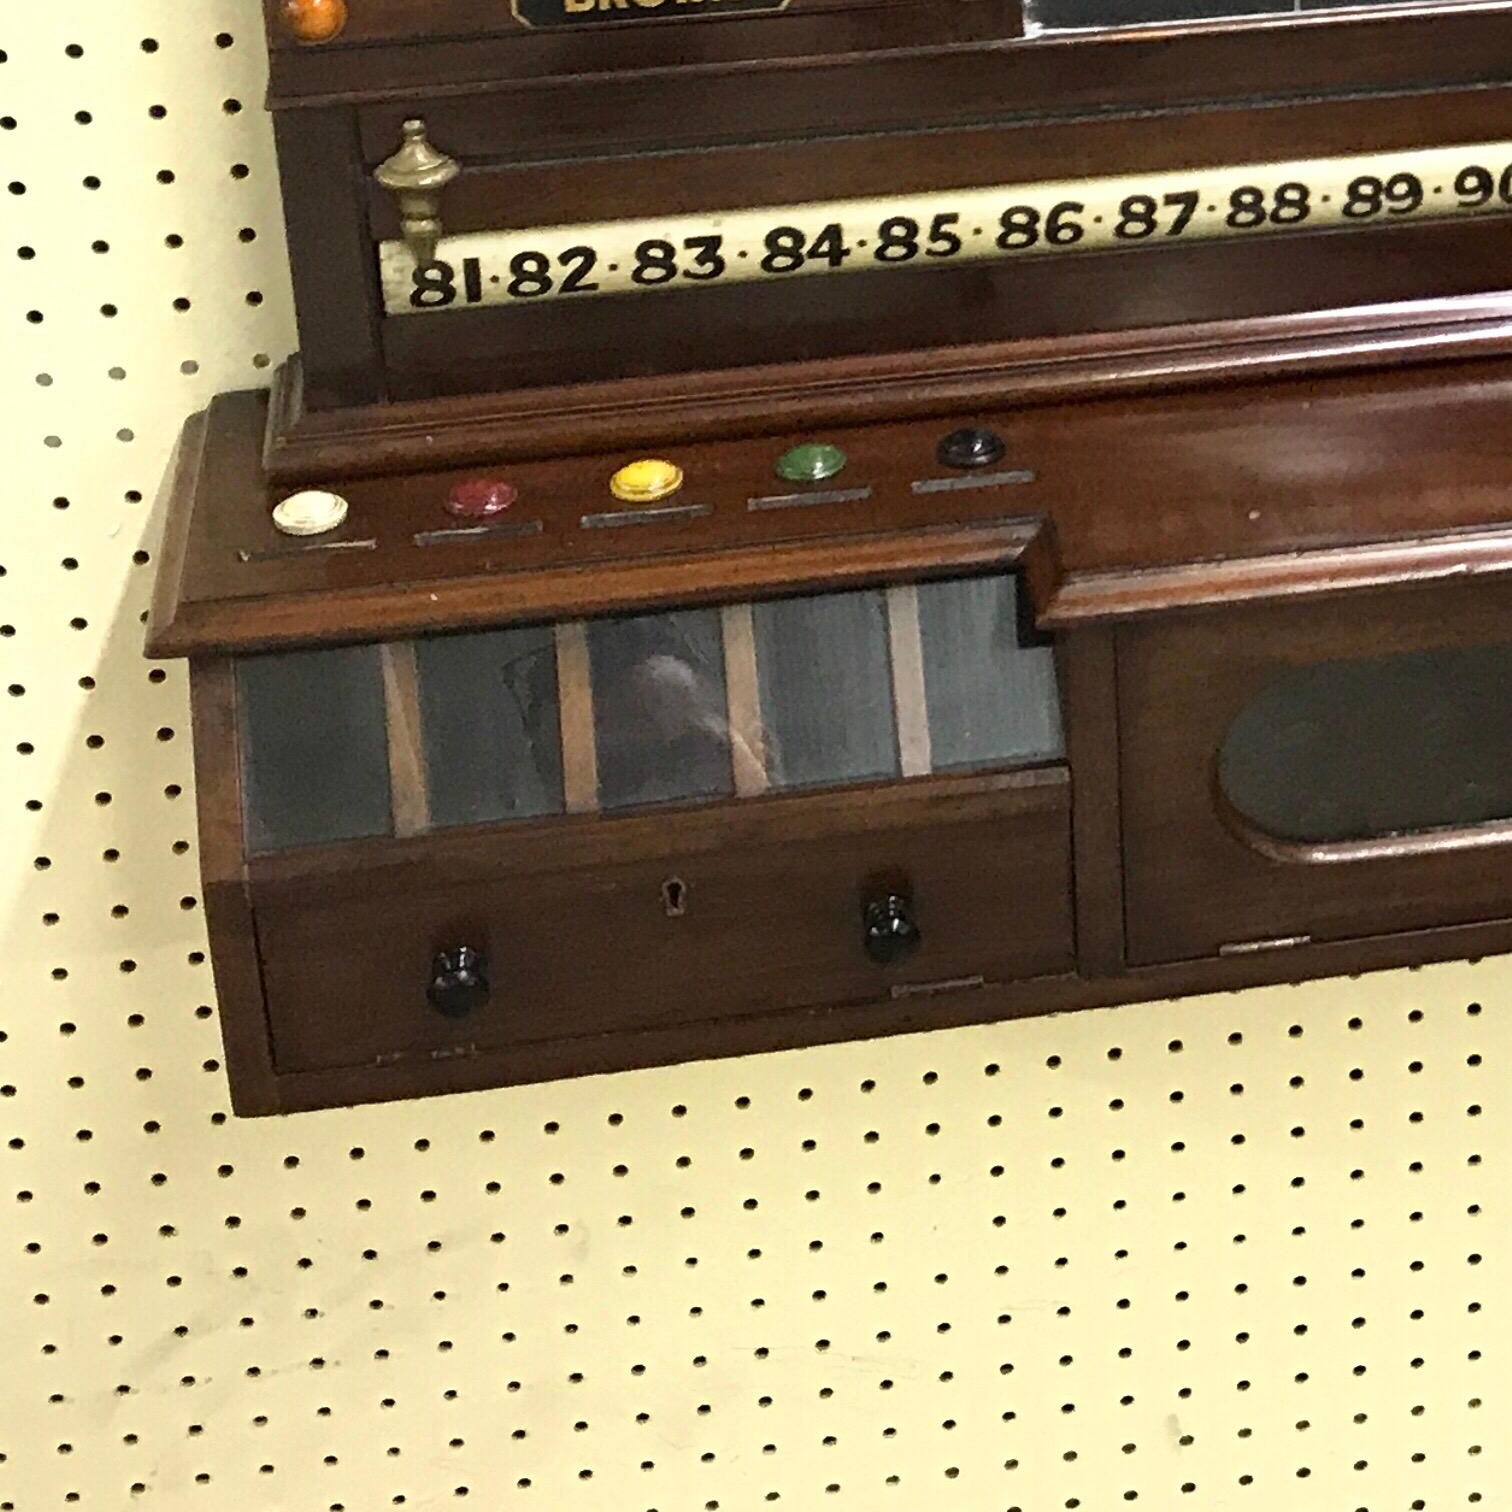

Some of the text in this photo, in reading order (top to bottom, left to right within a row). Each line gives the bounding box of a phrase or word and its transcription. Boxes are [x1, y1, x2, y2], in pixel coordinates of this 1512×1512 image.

[409, 257, 481, 308] 81
[508, 246, 599, 299] 82
[632, 235, 725, 286] 83
[761, 223, 850, 276] 84
[873, 213, 962, 265] 85
[996, 202, 1085, 252] 86
[1114, 190, 1199, 240] 87
[1225, 182, 1311, 232] 88
[1342, 172, 1424, 220] 89
